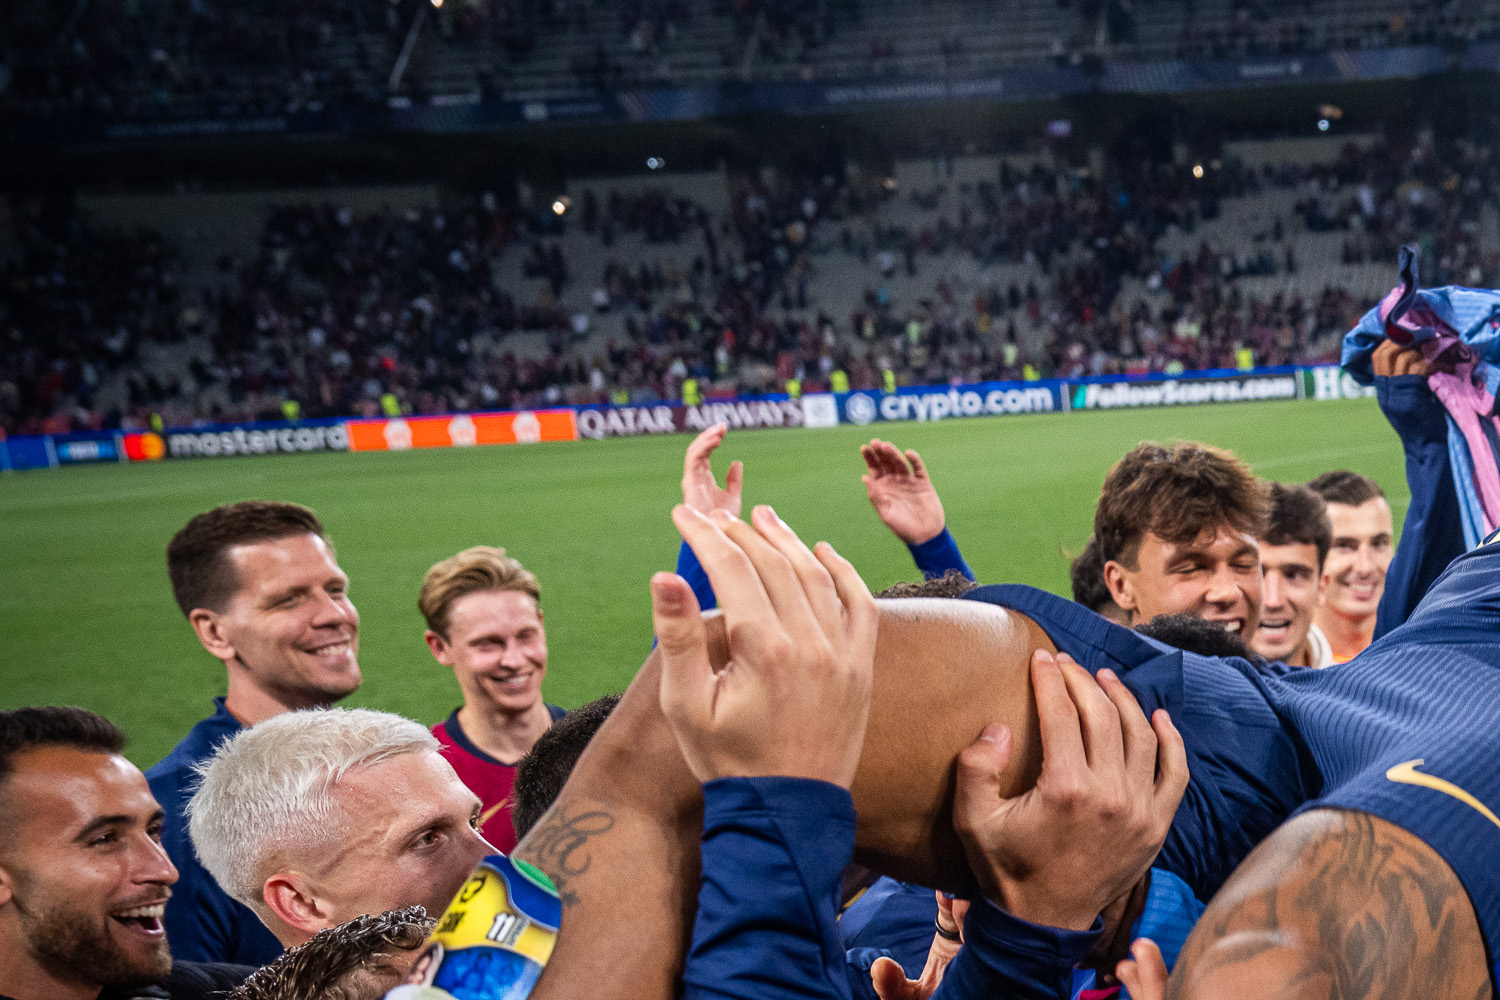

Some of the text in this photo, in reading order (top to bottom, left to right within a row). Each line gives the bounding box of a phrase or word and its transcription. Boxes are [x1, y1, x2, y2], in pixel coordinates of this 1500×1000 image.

[579, 399, 803, 439] QATAR AIRWAYS
[881, 387, 1053, 422] crypto.com
[168, 422, 349, 457] mastercard
